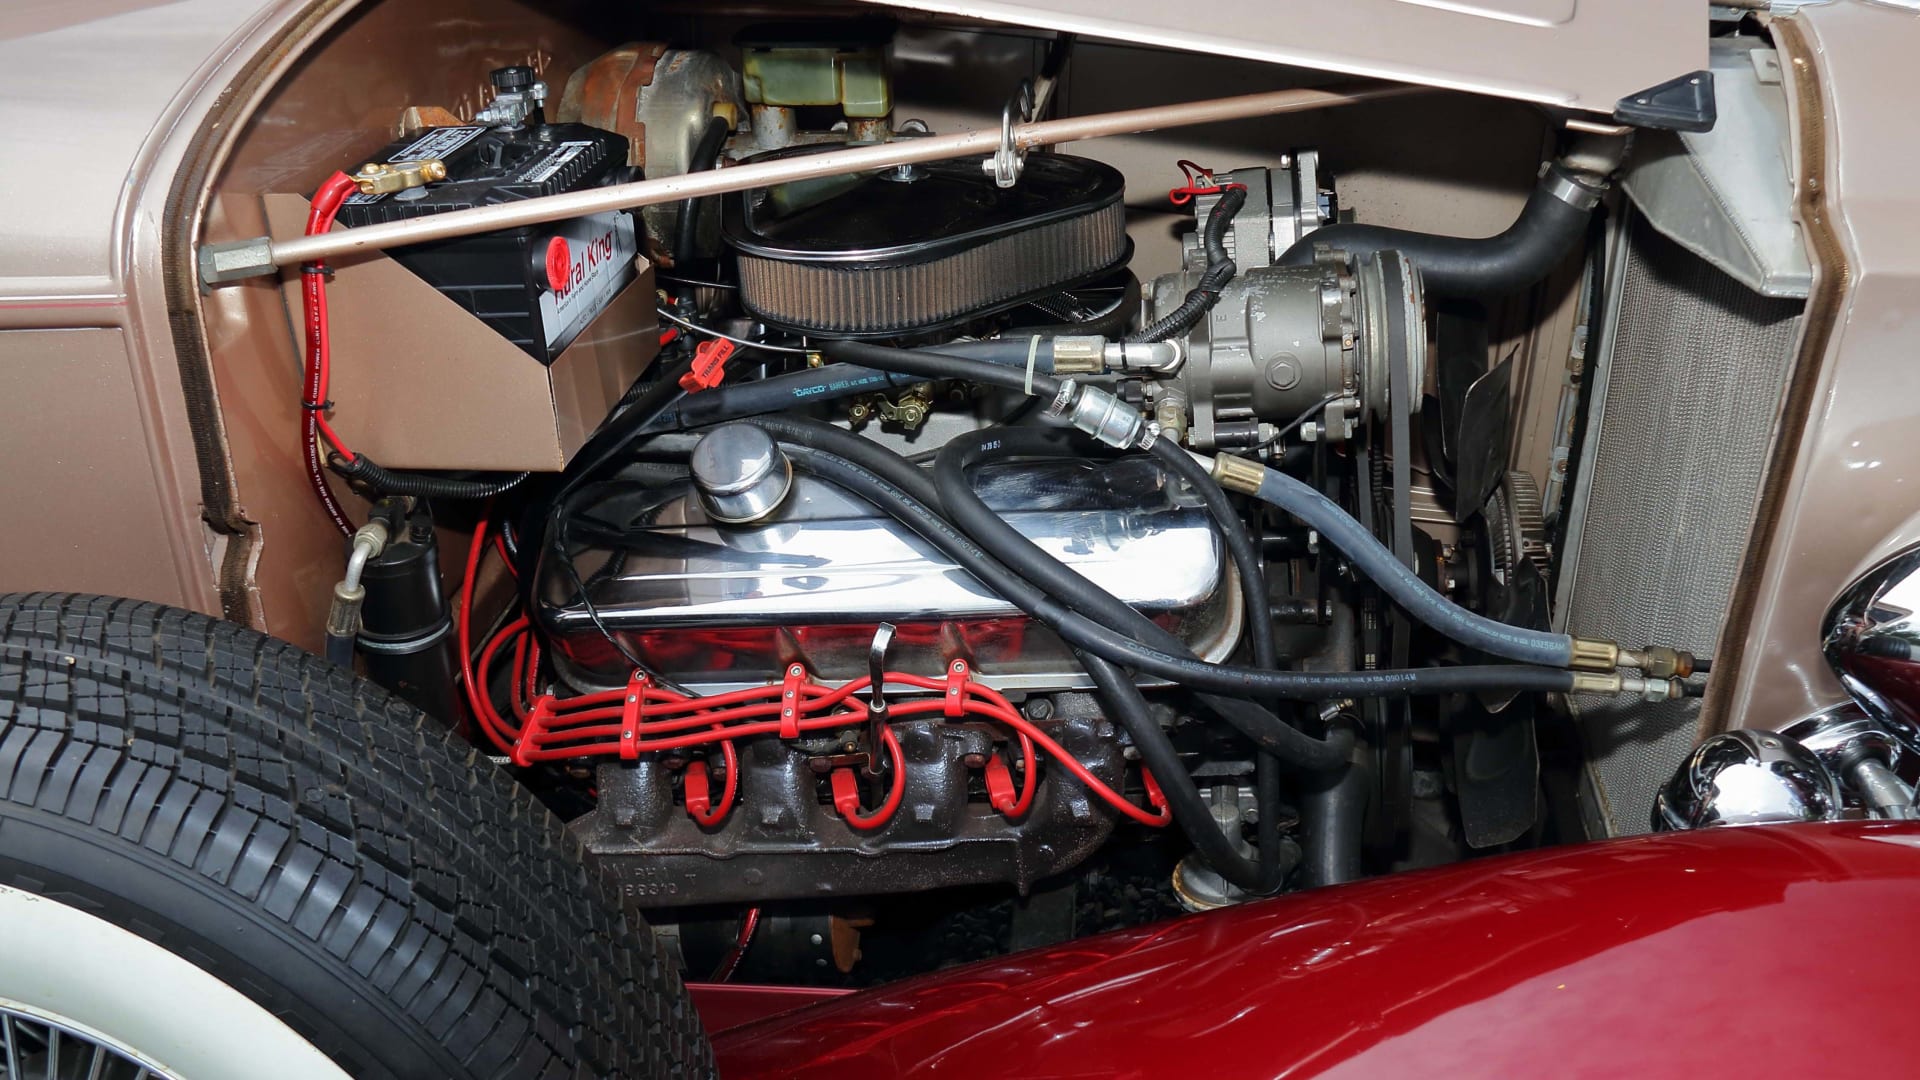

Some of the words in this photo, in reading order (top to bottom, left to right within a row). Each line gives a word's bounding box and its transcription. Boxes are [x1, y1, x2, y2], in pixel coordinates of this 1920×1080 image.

[588, 230, 612, 272] King
[702, 357, 718, 378] TRANS
[718, 344, 729, 359] FILL
[794, 384, 825, 396] DAYCO
[1123, 640, 1174, 663] DAYCO
